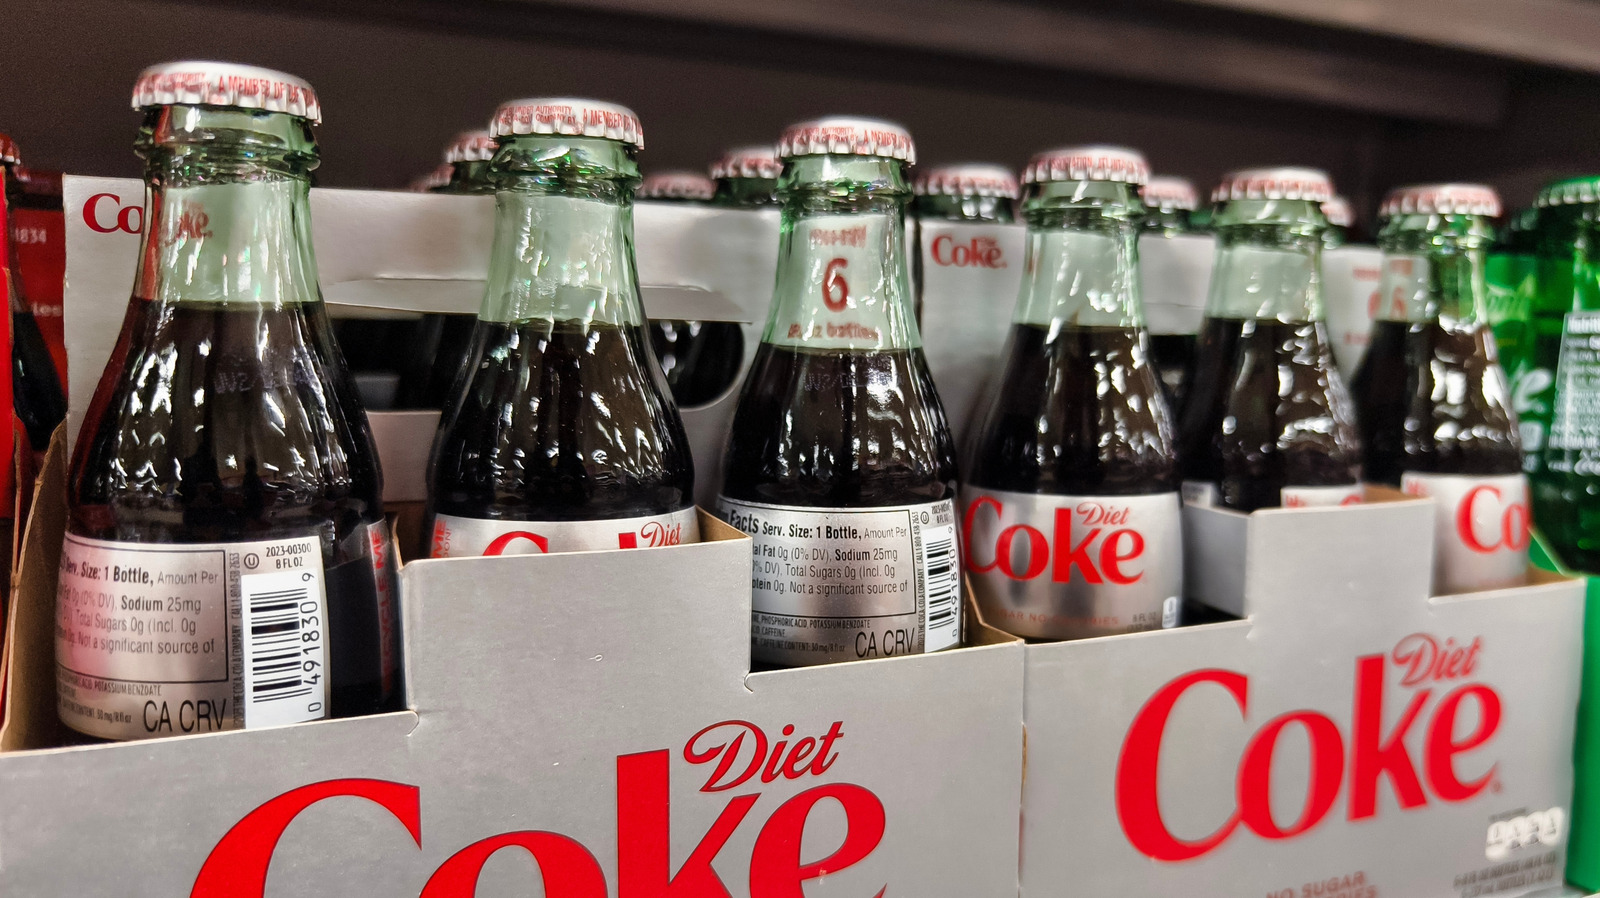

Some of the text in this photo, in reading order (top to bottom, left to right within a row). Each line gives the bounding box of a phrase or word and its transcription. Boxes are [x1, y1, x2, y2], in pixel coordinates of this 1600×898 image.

[822, 258, 849, 312] 6
[730, 509, 759, 534] Facts
[762, 521, 785, 536] Serv.
[788, 523, 813, 538] Size:
[816, 526, 821, 538] 1
[825, 525, 861, 541] Bottle,
[864, 527, 894, 539] Amount
[896, 526, 907, 538] Per
[1075, 501, 1130, 528] Diet
[641, 521, 682, 548] Diet
[963, 494, 1146, 585] Coke
[266, 543, 312, 557] 2023-00300
[283, 558, 293, 568] FL
[370, 530, 385, 569] ME
[763, 544, 775, 557] Fat
[778, 546, 788, 561] 0g
[791, 548, 808, 561] (0%
[835, 548, 870, 561] Sodium
[873, 547, 897, 561] 25mg
[81, 561, 101, 580] Size:
[104, 566, 109, 580] 1
[114, 565, 154, 586] Bottle,
[158, 571, 197, 584] Amount
[201, 570, 218, 584] Per
[785, 563, 806, 577] Total
[810, 565, 841, 579] Sugars
[845, 566, 856, 580] 0g
[859, 565, 882, 579] (Incl.
[884, 564, 895, 579] 0g
[773, 579, 787, 594] 0g.
[790, 581, 806, 594] Not
[808, 585, 814, 594] a
[816, 582, 864, 597] significant
[867, 582, 897, 595] source
[899, 580, 908, 592] of
[121, 595, 163, 612] Sodium
[167, 597, 201, 614] 25mg
[1029, 613, 1046, 623] NO
[95, 613, 127, 632] Sugars
[131, 617, 144, 636] 0g
[148, 618, 177, 635] (Incl.
[181, 618, 196, 635] 0g
[761, 614, 794, 627] PHOSPHORIC
[809, 619, 842, 629] POTASSIUM
[842, 619, 871, 629] BENZOATE
[761, 625, 785, 638] CAFFEINE
[93, 637, 97, 649] a
[100, 635, 153, 654] significant
[157, 641, 198, 654] source
[202, 638, 215, 653] of
[302, 572, 314, 582] 9
[308, 702, 322, 713] 0
[855, 627, 915, 658] CA CRV
[1392, 632, 1483, 688] Diet
[128, 684, 162, 696] BENZOATE
[143, 699, 227, 732] CA CRV
[684, 719, 845, 793] Diet
[1114, 653, 1503, 864] Coke
[188, 748, 888, 898] Coke
[1301, 870, 1366, 898] SUGAR
